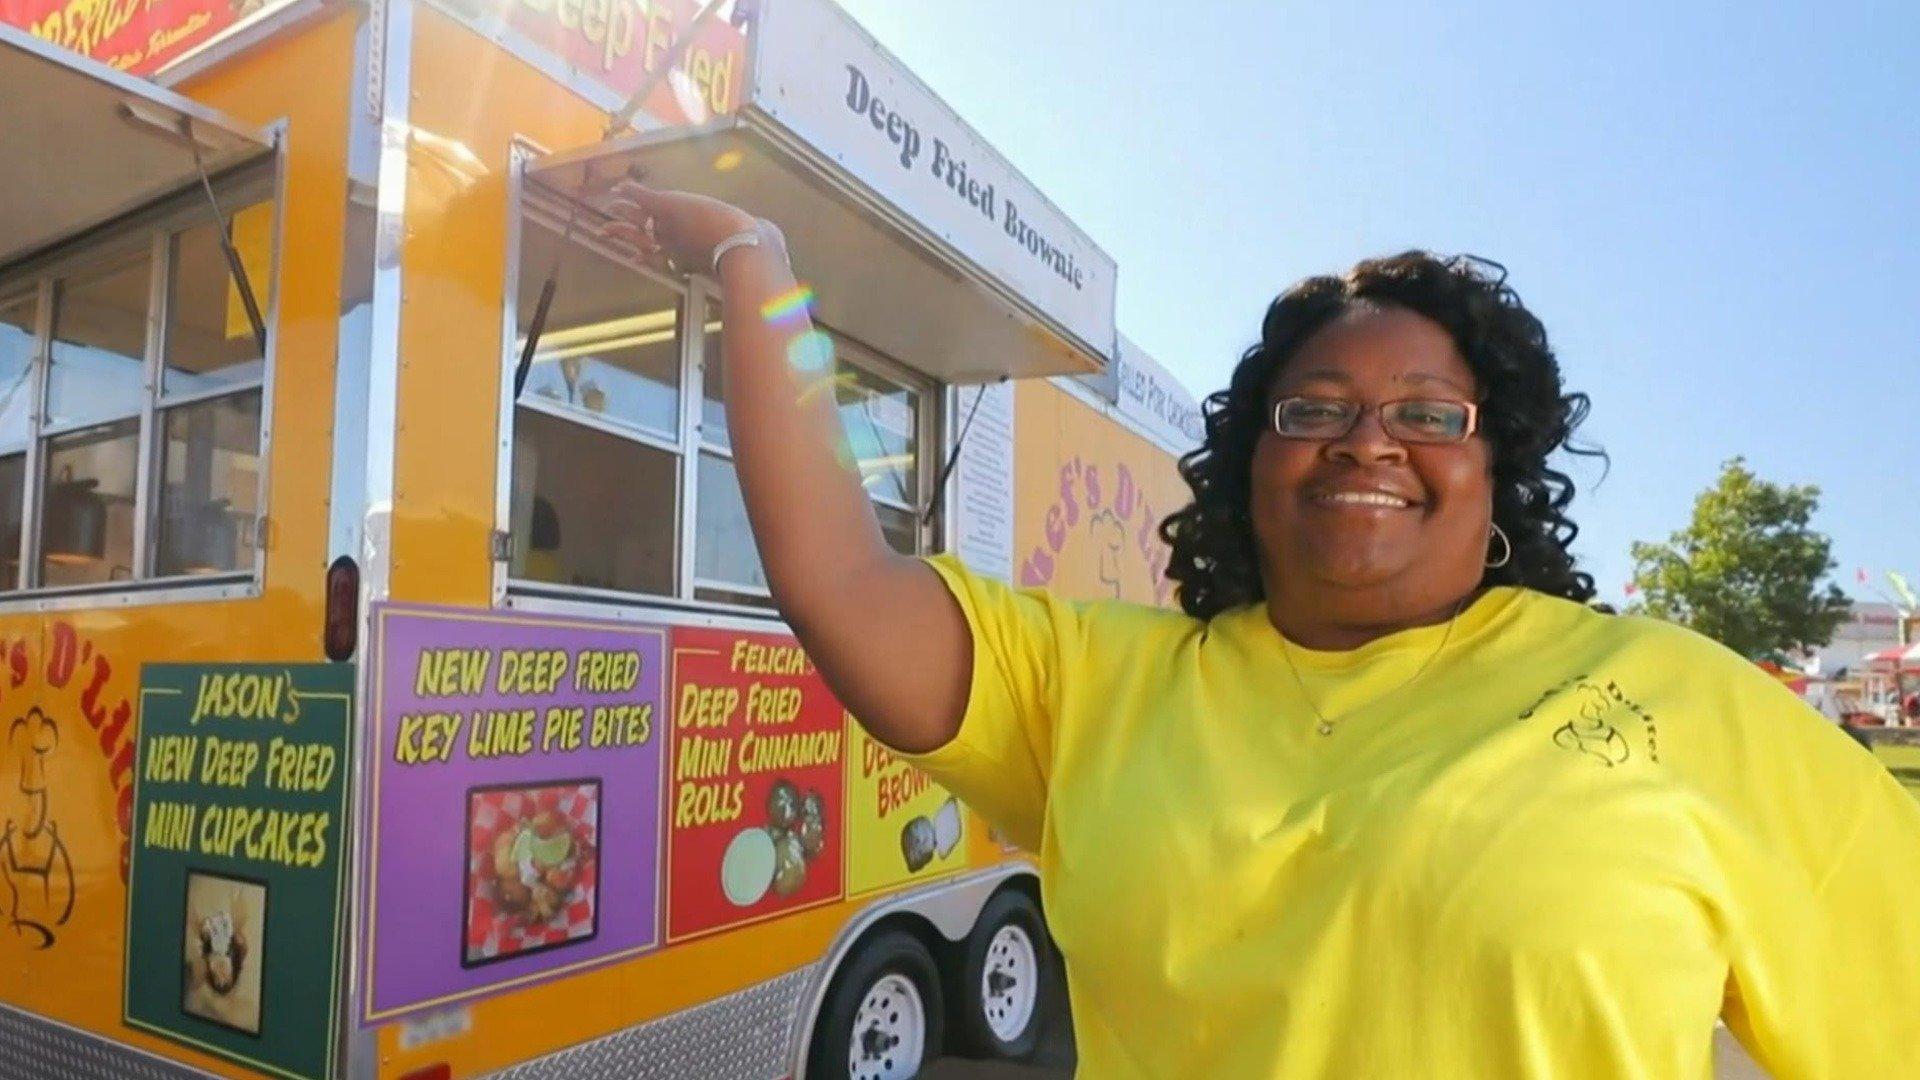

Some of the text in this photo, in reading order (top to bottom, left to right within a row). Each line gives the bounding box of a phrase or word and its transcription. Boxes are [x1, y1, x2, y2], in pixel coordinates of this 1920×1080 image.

[845, 64, 1082, 290] Deep Fried Brownie
[415, 648, 642, 697] NEW DEEP FRIED
[731, 638, 816, 675] FELICIA
[677, 681, 802, 729] DEEP FRIED
[394, 703, 653, 764] KEY LIME PIE BITES
[677, 729, 842, 782] MINI CINNAMON
[145, 736, 335, 792] NEW DEEP FRIED
[675, 780, 746, 828] ROLLS
[145, 802, 330, 868] MINI CUPCAKES
